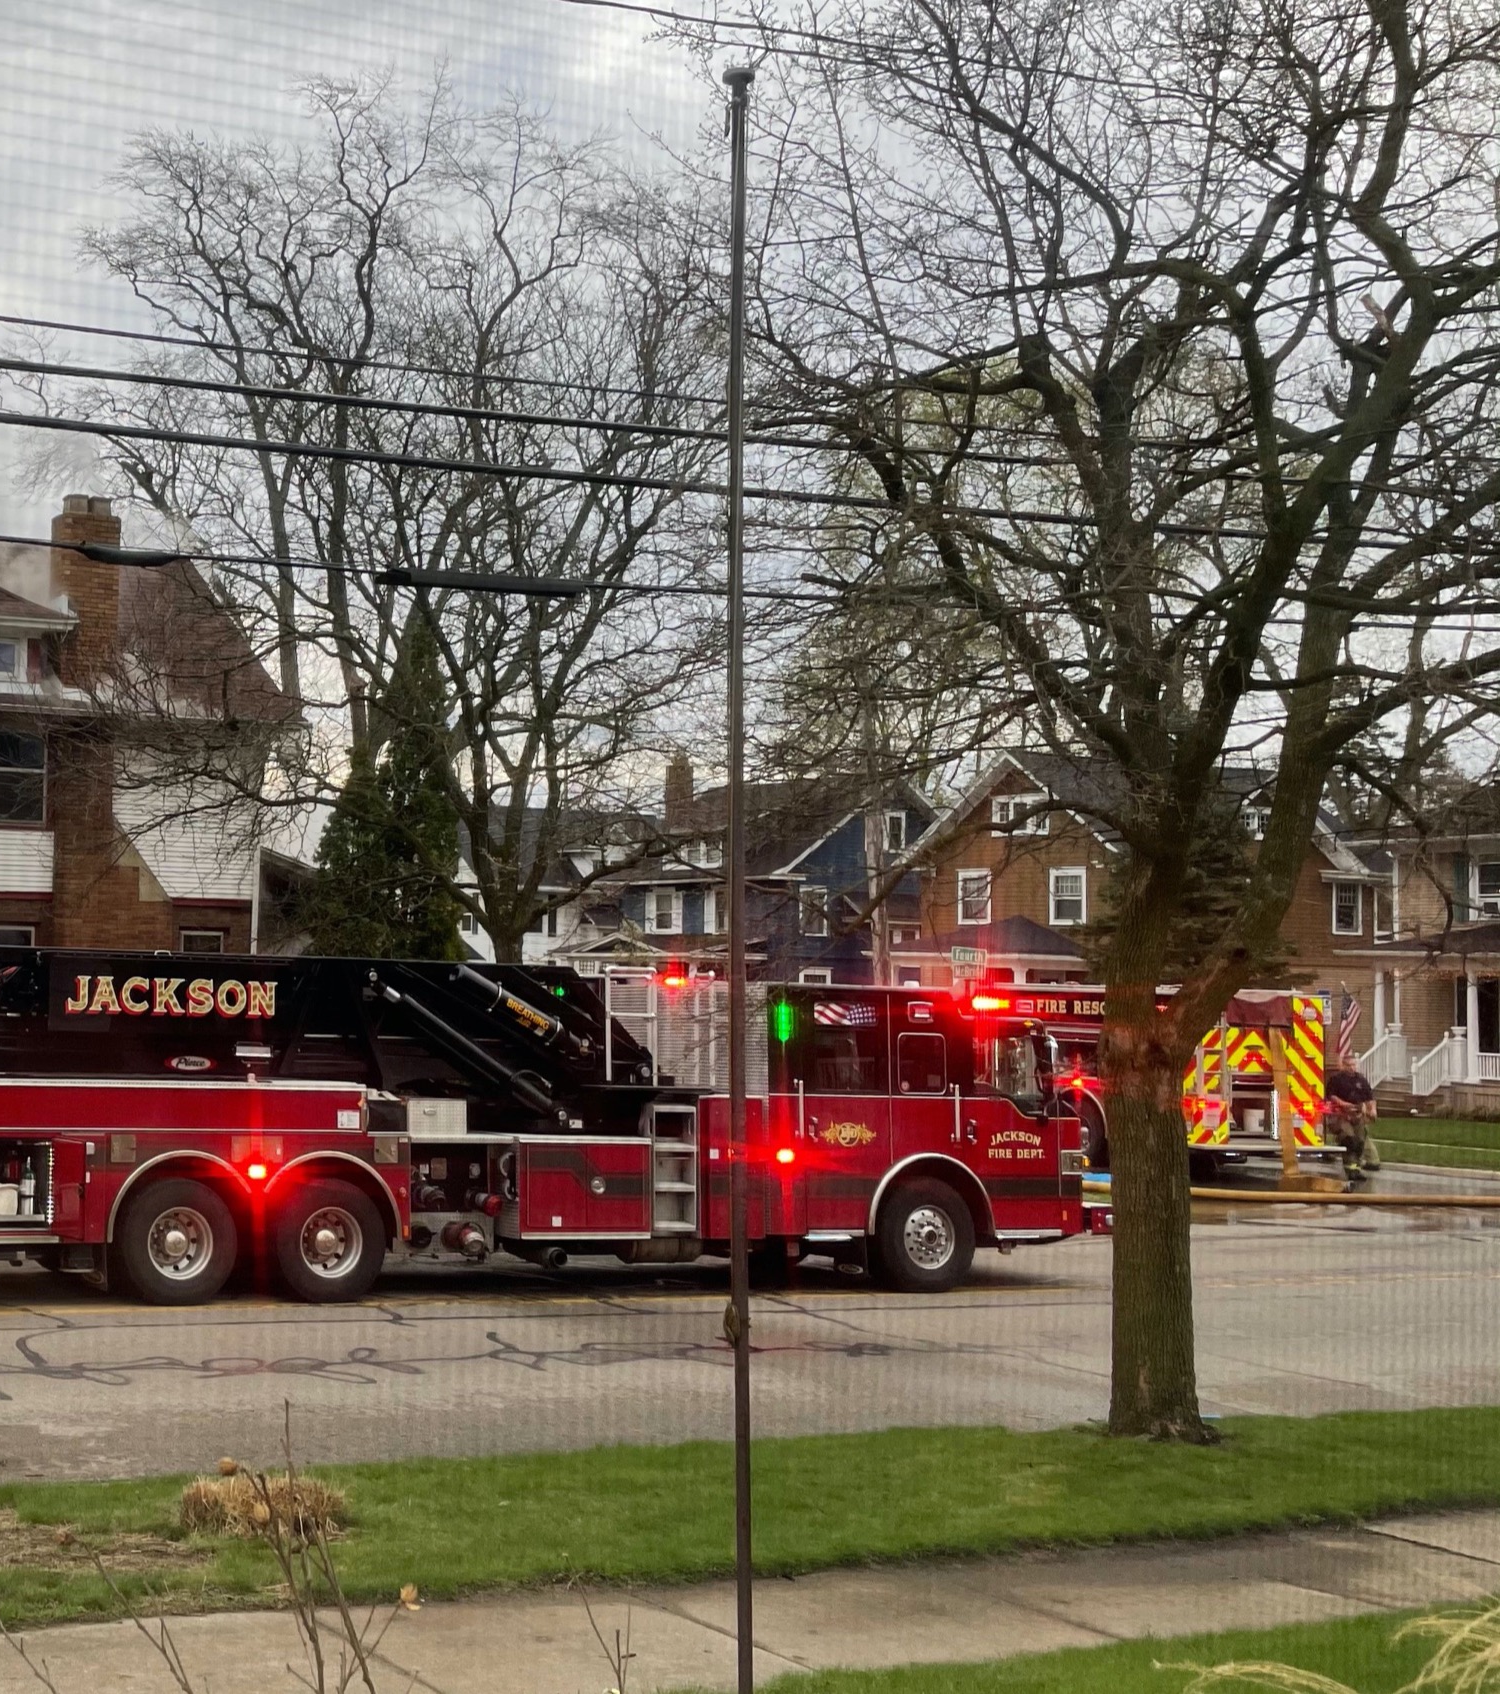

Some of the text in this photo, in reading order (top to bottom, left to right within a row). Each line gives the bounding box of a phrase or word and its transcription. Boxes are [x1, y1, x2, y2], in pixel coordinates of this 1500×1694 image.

[955, 949, 984, 963] Fourth
[954, 965, 984, 979] McBri
[65, 975, 278, 1019] JACKSON
[506, 997, 550, 1030] BREATHING
[1036, 999, 1105, 1016] FIRE RESC
[990, 1130, 1041, 1147] JACKSON
[988, 1148, 1046, 1159] FIRE DEPT.
